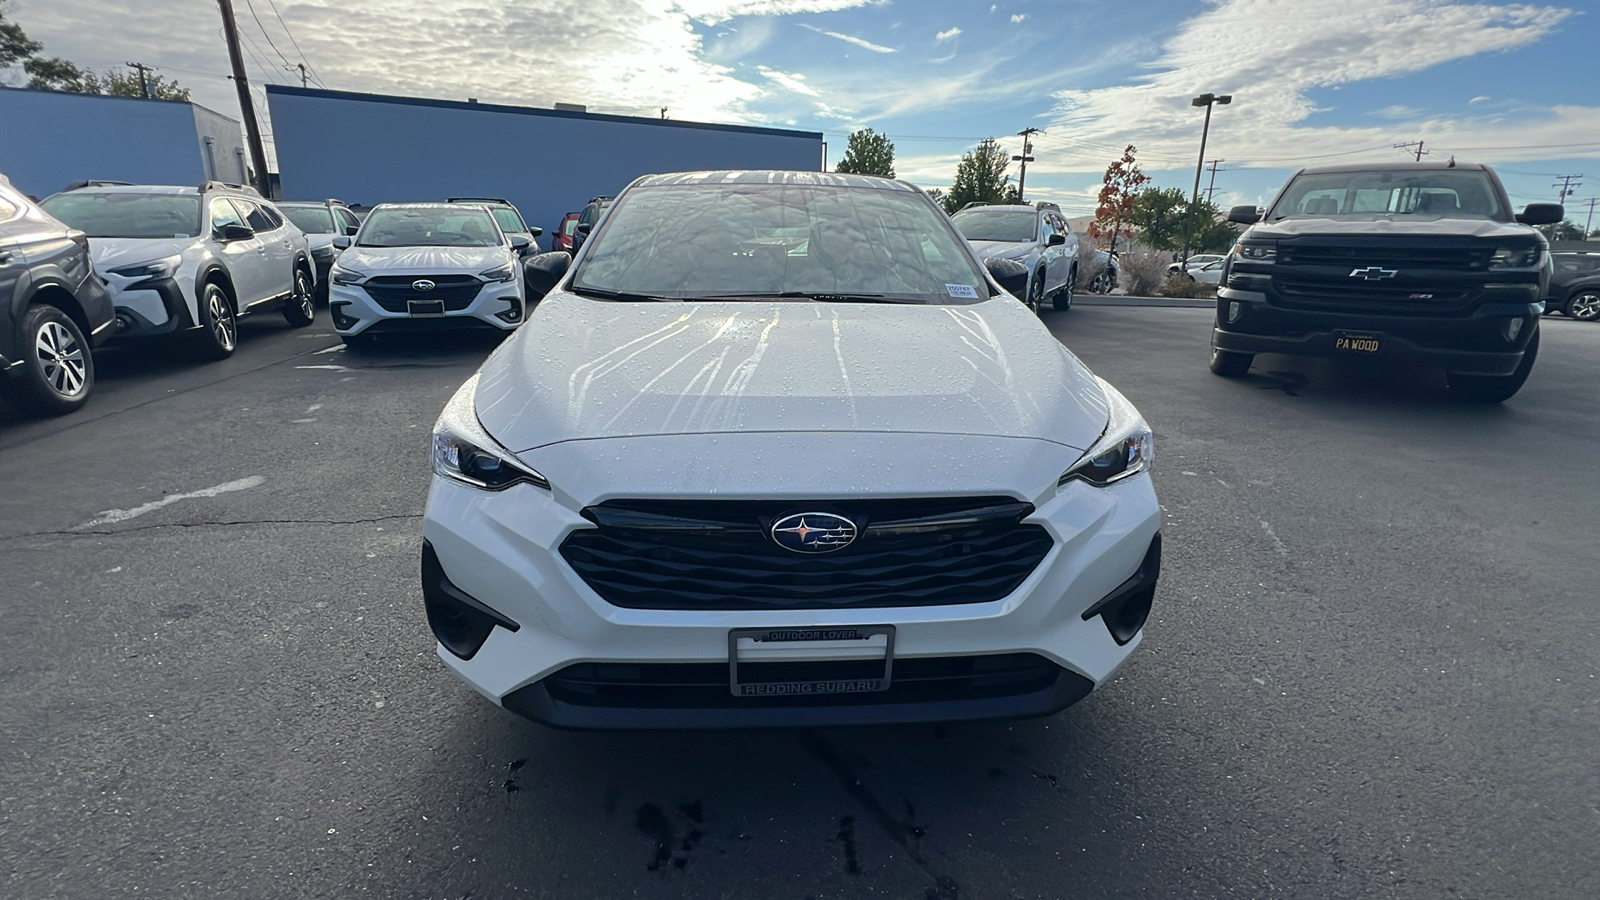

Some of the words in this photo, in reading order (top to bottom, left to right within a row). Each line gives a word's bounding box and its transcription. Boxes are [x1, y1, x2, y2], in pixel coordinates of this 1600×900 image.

[1336, 338, 1349, 349] PA
[1351, 339, 1379, 351] WOOD
[770, 631, 820, 641] OUTDOOR
[822, 630, 856, 640] LOVER
[745, 683, 812, 695] REDDING
[815, 680, 877, 693] SUBARU
